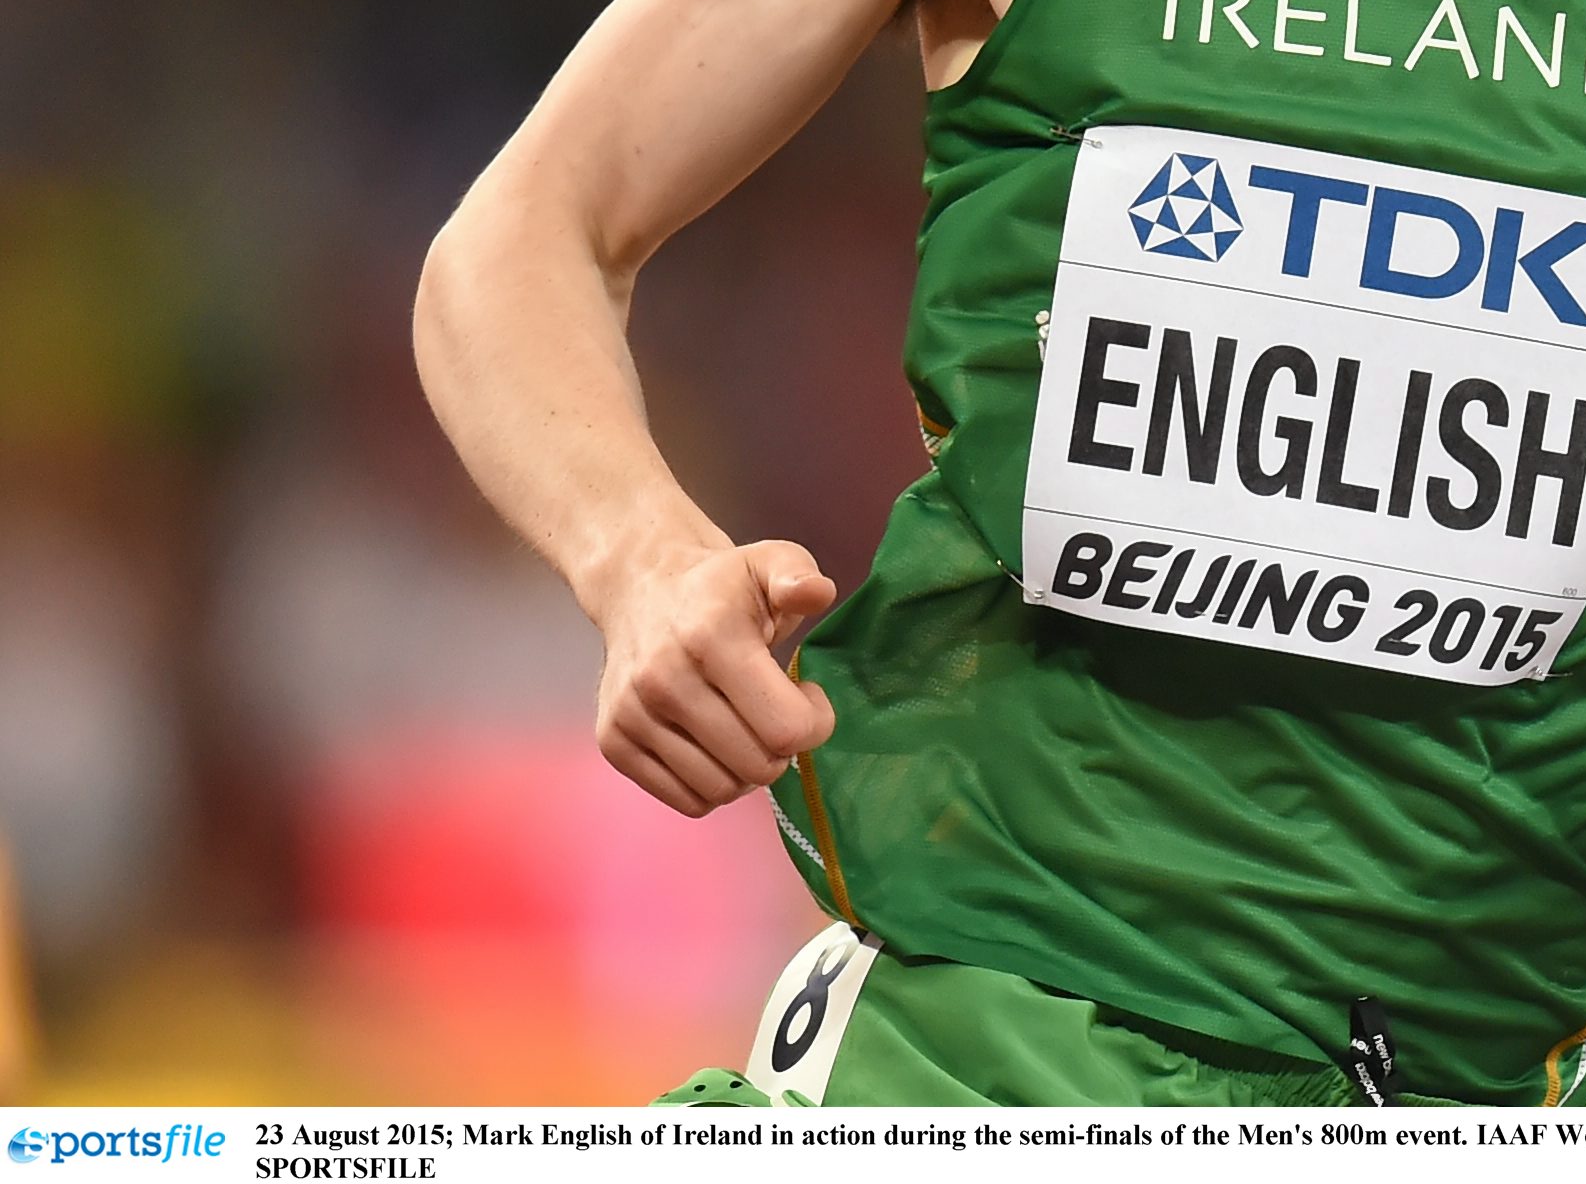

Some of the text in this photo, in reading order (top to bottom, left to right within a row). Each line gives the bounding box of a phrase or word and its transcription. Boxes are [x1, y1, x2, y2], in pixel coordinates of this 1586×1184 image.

[1051, 532, 1564, 673] BEIJING 2015
[771, 942, 860, 1073] 8
